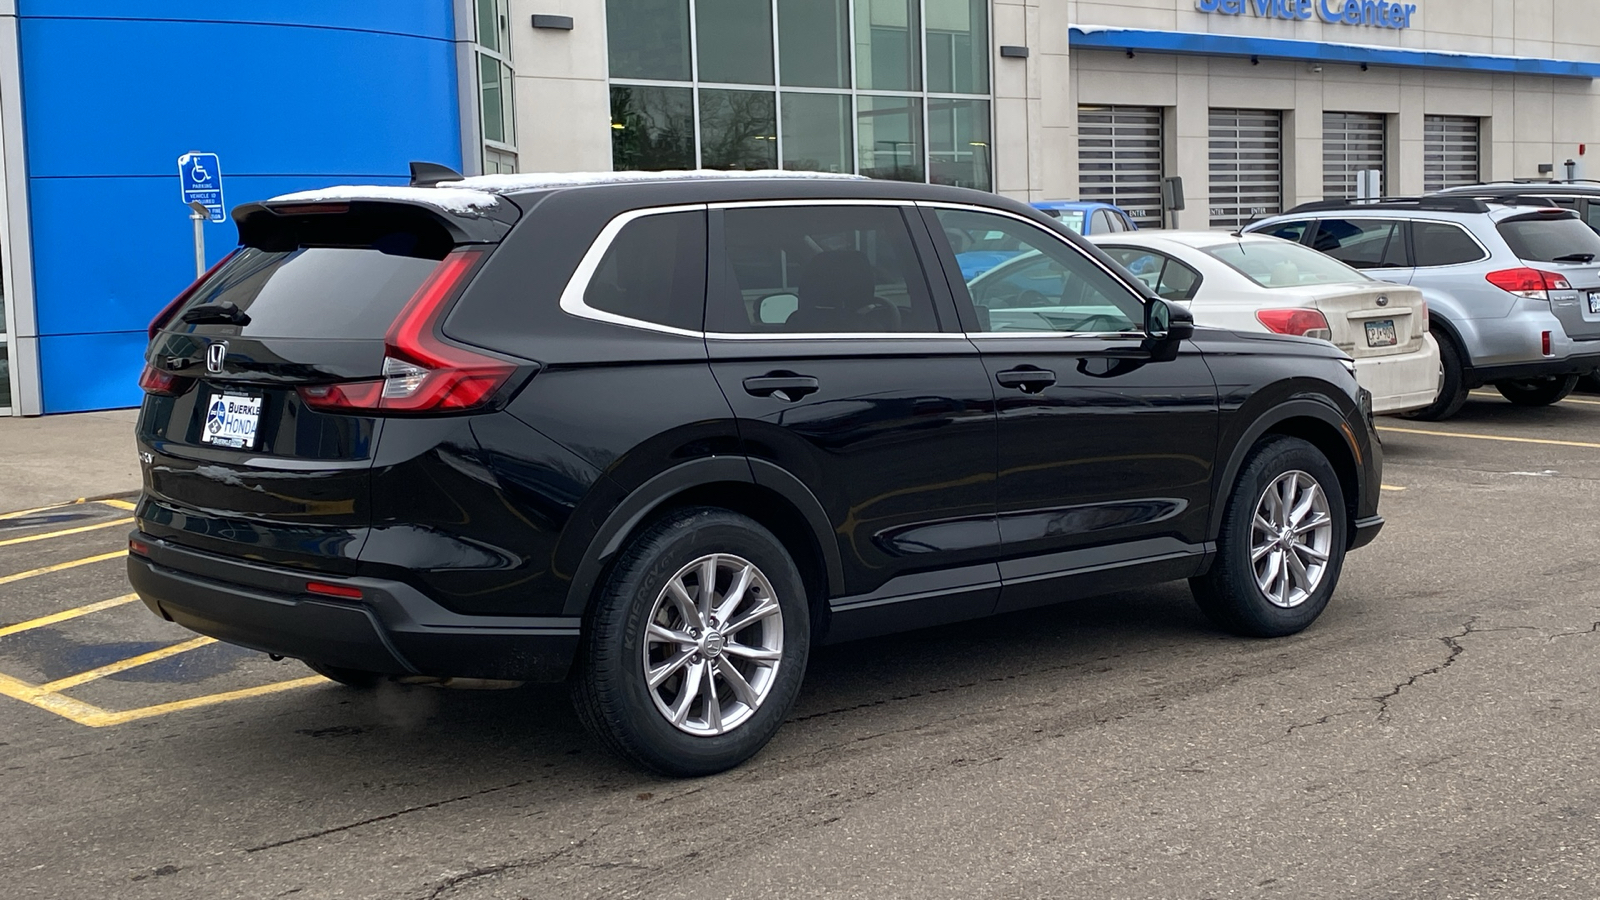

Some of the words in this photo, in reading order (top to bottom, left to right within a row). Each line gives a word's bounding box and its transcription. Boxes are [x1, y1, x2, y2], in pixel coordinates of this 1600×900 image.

[1316, 0, 1416, 29] Center
[228, 402, 260, 415] BUERKLE
[225, 415, 256, 434] HONDA
[624, 560, 658, 650] KINERGY
